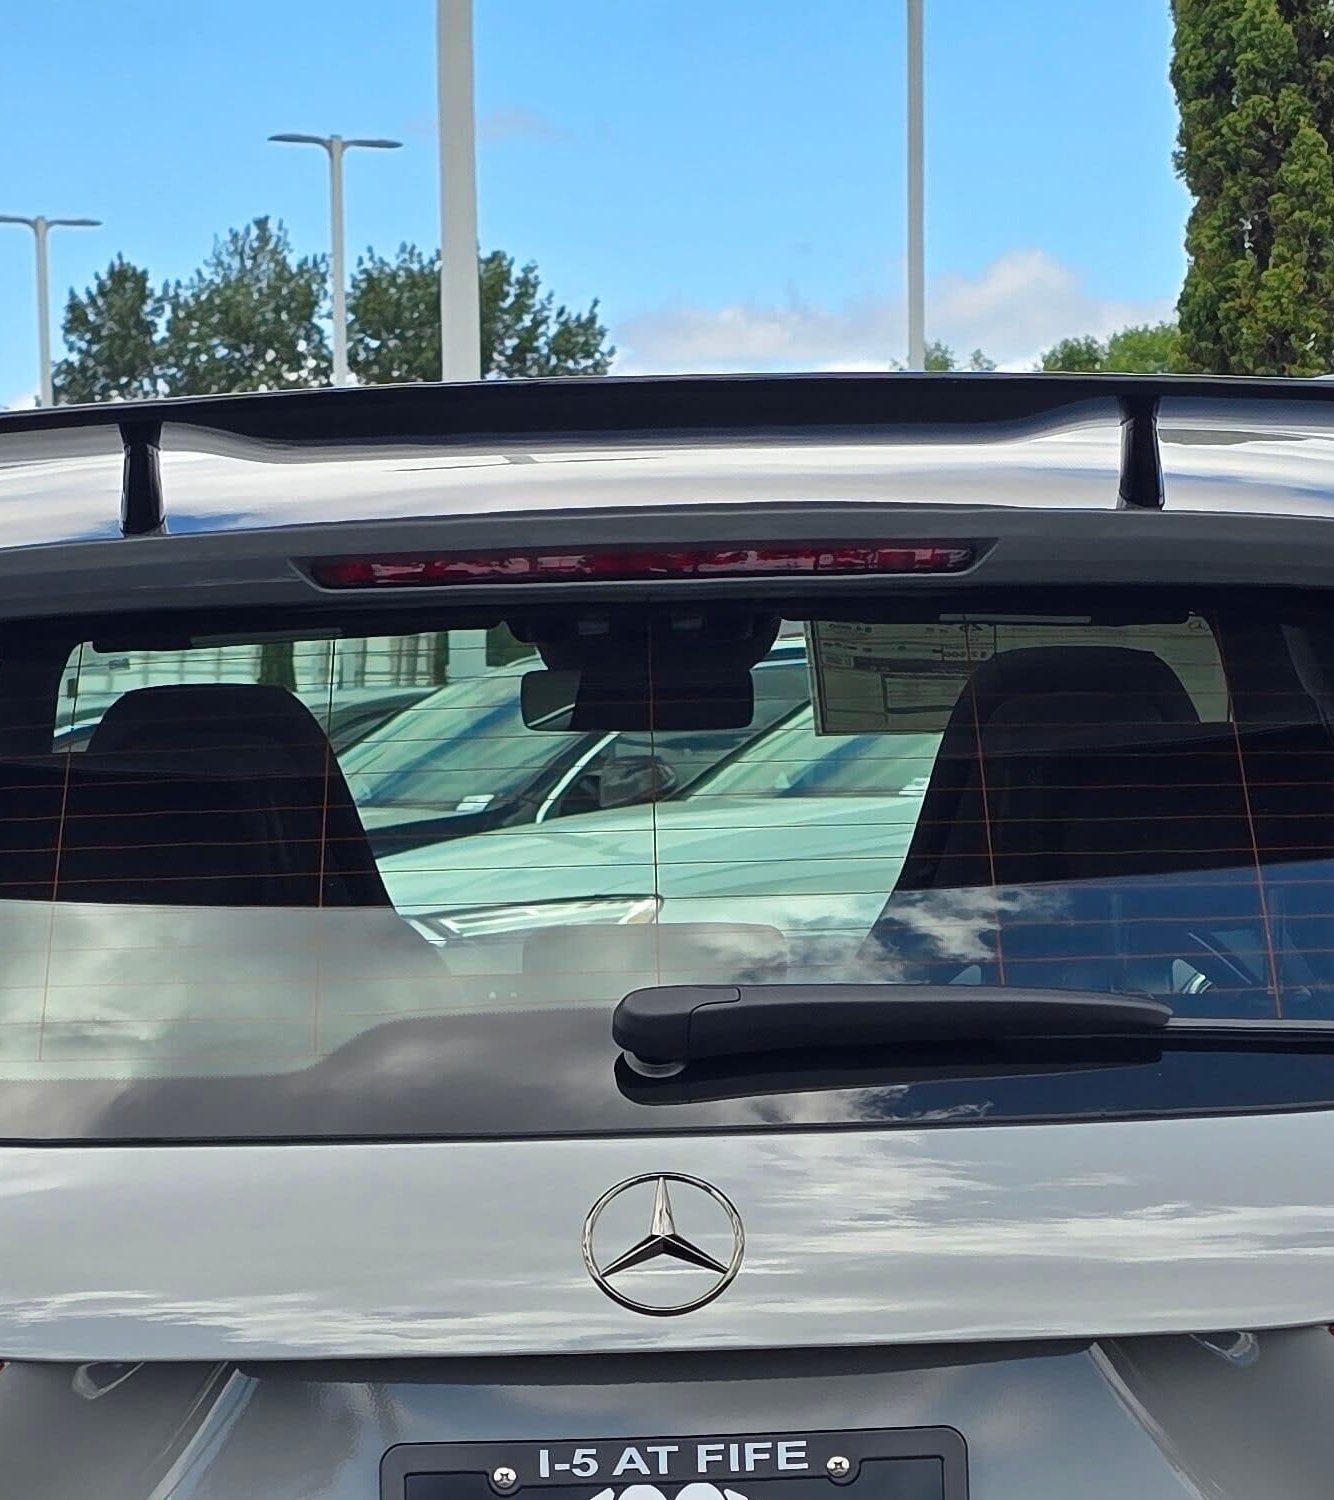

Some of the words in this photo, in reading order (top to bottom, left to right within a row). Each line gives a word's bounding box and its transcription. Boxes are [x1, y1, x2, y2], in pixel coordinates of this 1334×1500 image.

[539, 1448, 599, 1478] I-5
[612, 1445, 678, 1475] AT
[697, 1440, 809, 1472] FIFE
